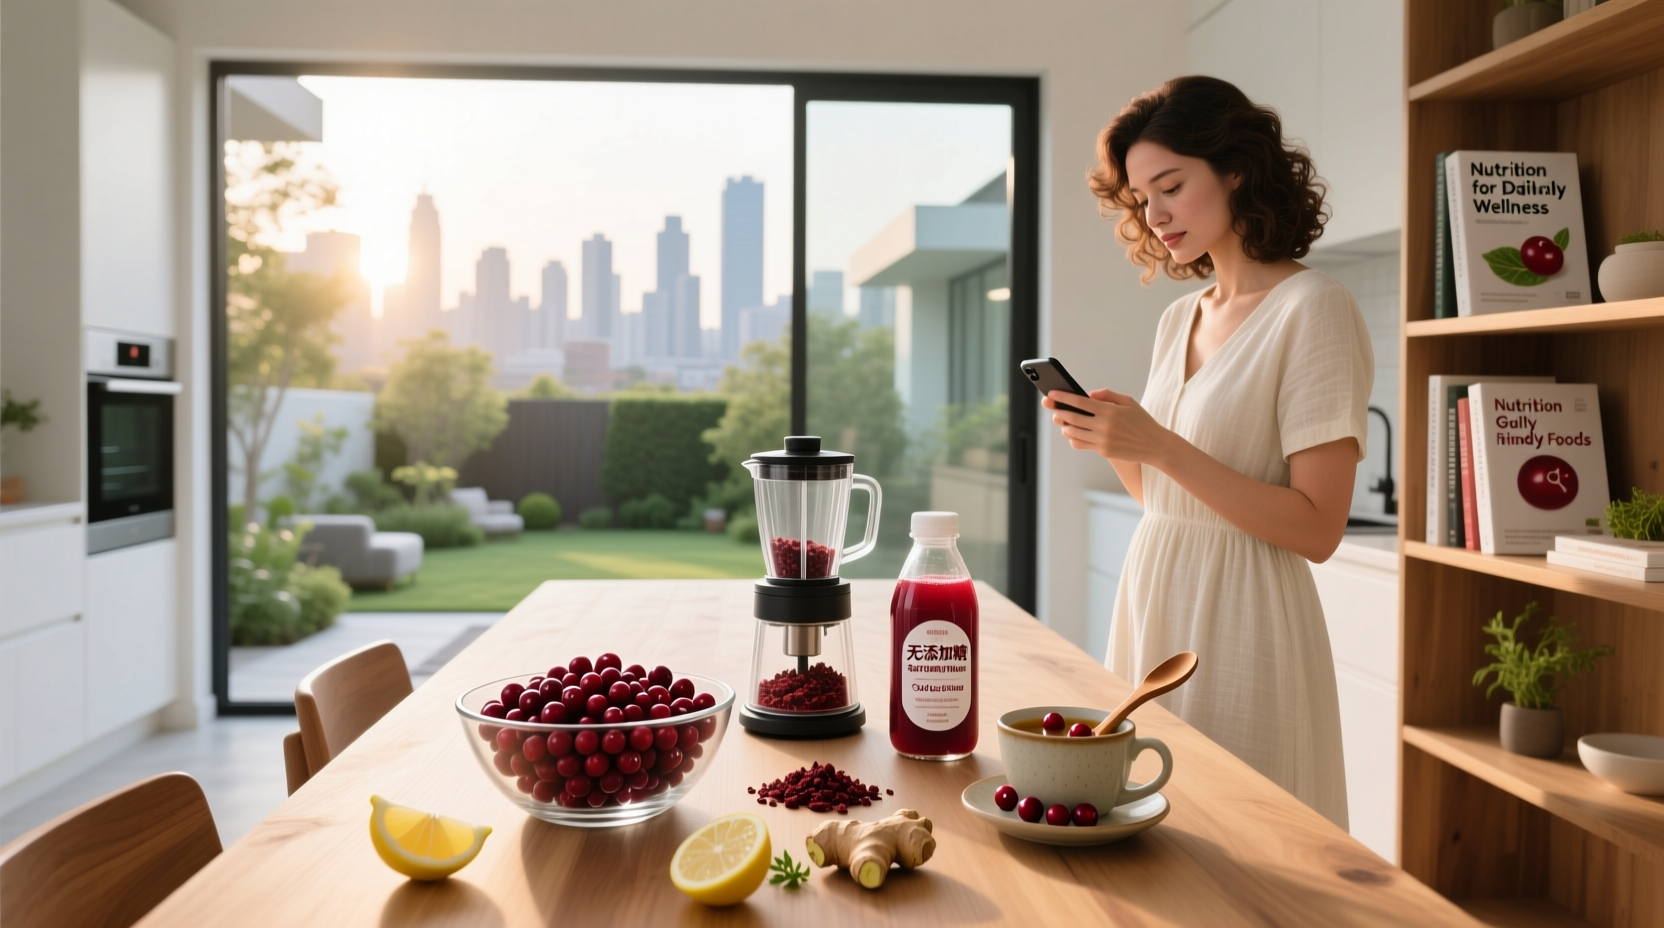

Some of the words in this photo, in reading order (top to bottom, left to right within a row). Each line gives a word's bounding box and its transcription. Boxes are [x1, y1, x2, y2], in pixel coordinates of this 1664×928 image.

[1471, 161, 1547, 177] Nutrition
[1473, 180, 1497, 195] for
[1473, 199, 1549, 214] Wellness
[1494, 398, 1562, 413] Nutrition
[1547, 431, 1592, 446] Foods
